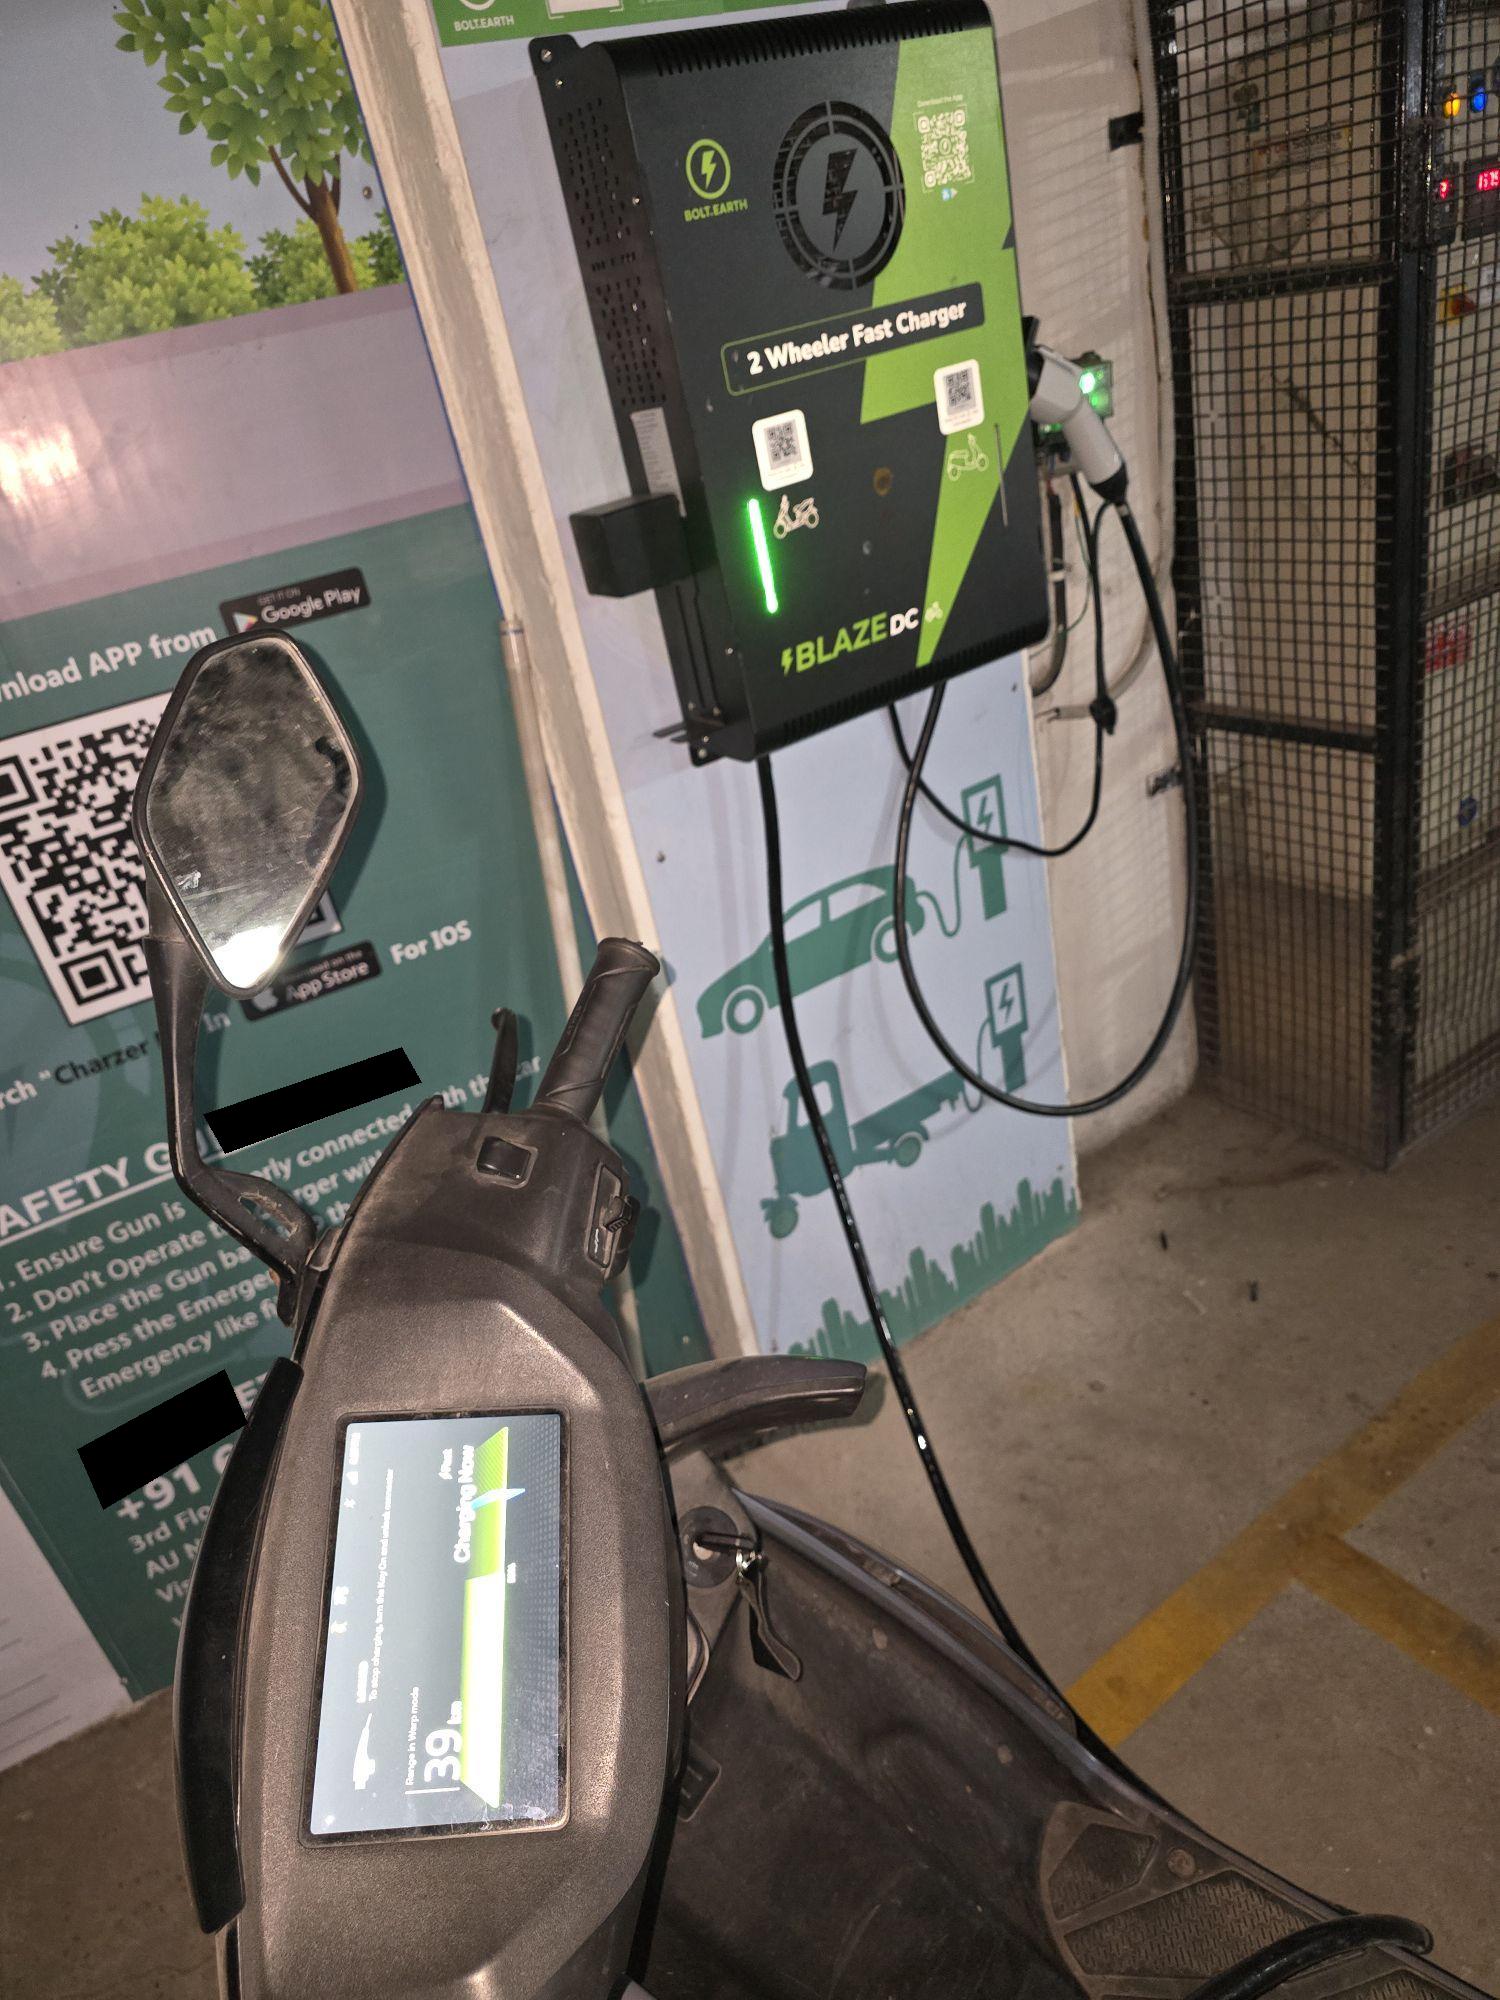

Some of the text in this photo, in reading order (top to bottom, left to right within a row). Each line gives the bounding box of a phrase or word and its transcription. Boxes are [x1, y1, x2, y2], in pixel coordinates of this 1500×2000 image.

[453, 15, 515, 32] BOLT.EARTH
[684, 198, 748, 222] BOLT.EARTH
[746, 301, 968, 376] 2 Wheeler Fast Charger
[261, 587, 361, 624] Google Play
[0, 626, 218, 701] nload APP from
[795, 607, 919, 673] BLAZE DC
[321, 961, 370, 988] Store
[390, 920, 472, 965] For IOS
[14, 1234, 105, 1282] Ensure
[106, 1212, 162, 1244] Gun
[161, 1201, 187, 1224] is
[296, 1103, 414, 1168] connected
[4, 1302, 34, 1324] 2.
[106, 1228, 208, 1281] Operate
[20, 1330, 50, 1353] 3.
[49, 1301, 120, 1341] Place
[120, 1282, 165, 1313] the
[165, 1259, 219, 1293] Gun
[41, 1359, 67, 1380] 4.
[65, 1331, 132, 1370] Press
[132, 1312, 177, 1342] the
[79, 1329, 213, 1400] Emergency
[213, 1310, 259, 1341] like
[128, 1521, 172, 1554] 3rd
[453, 1445, 478, 1564] Charging Now
[146, 1550, 180, 1580] AU
[405, 1686, 419, 1786] Range in Warp mode
[424, 1728, 463, 1783] 39
